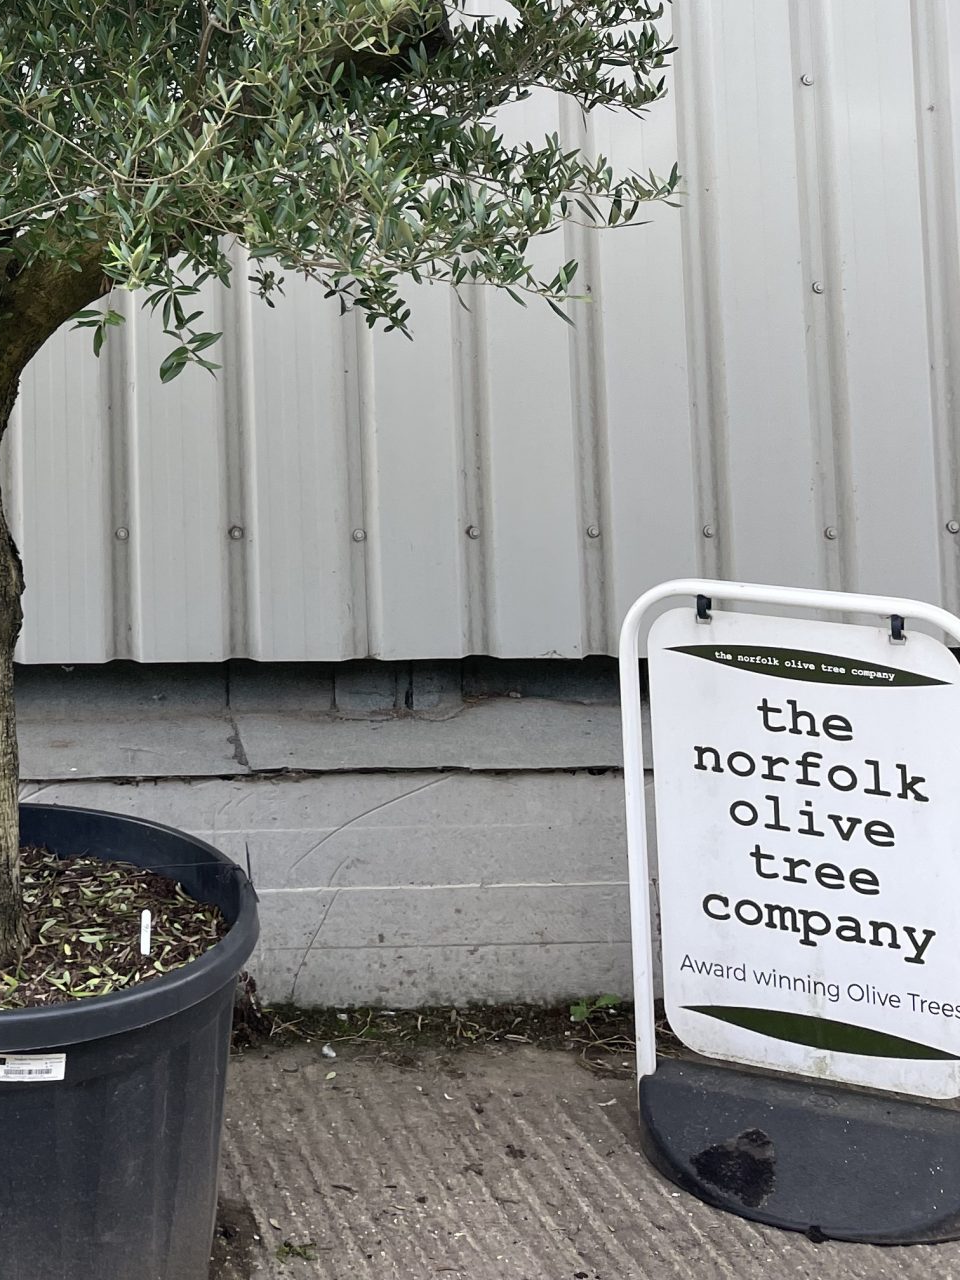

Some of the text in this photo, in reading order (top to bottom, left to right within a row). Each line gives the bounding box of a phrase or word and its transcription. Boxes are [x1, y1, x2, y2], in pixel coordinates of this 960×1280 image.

[714, 651, 896, 682] the norfolk olive tree company
[756, 697, 853, 742] the
[693, 745, 930, 803] norfolk
[729, 794, 895, 848] olive
[749, 844, 880, 896] tree
[702, 893, 936, 965] company
[680, 954, 747, 983] Award
[753, 968, 840, 1003] winning
[846, 982, 901, 1009] Olive
